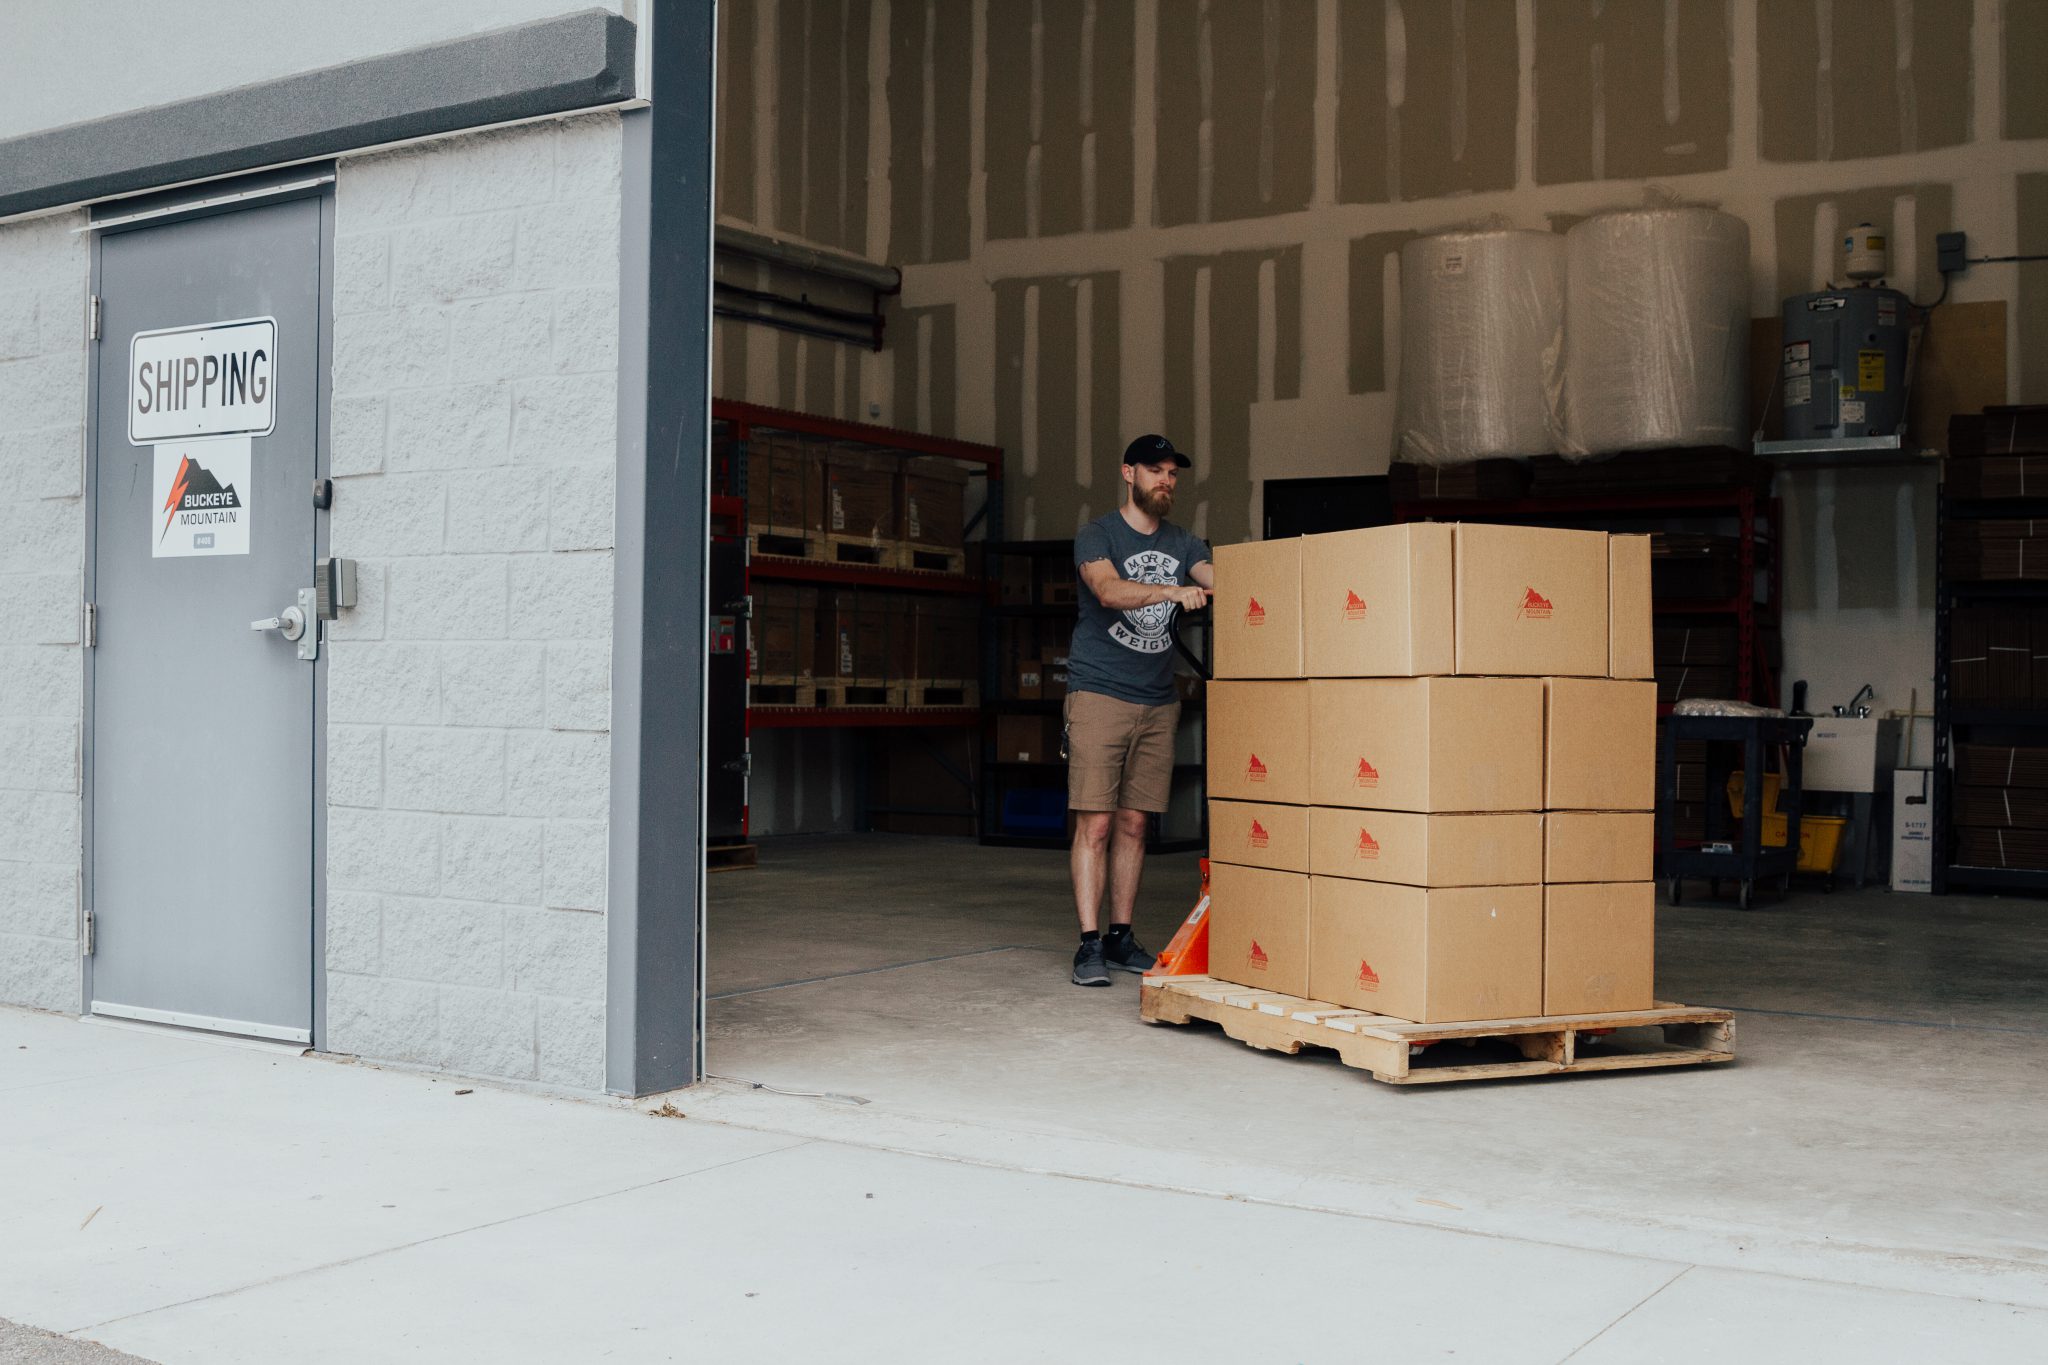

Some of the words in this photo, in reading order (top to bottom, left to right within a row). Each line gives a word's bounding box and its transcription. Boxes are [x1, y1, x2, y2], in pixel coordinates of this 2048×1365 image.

[137, 349, 267, 414] SHIPPING
[184, 492, 233, 508] BUCKEYE
[180, 511, 237, 526] MOUNTAIN
[1128, 554, 1171, 570] MORE
[1115, 626, 1169, 650] WEIGH
